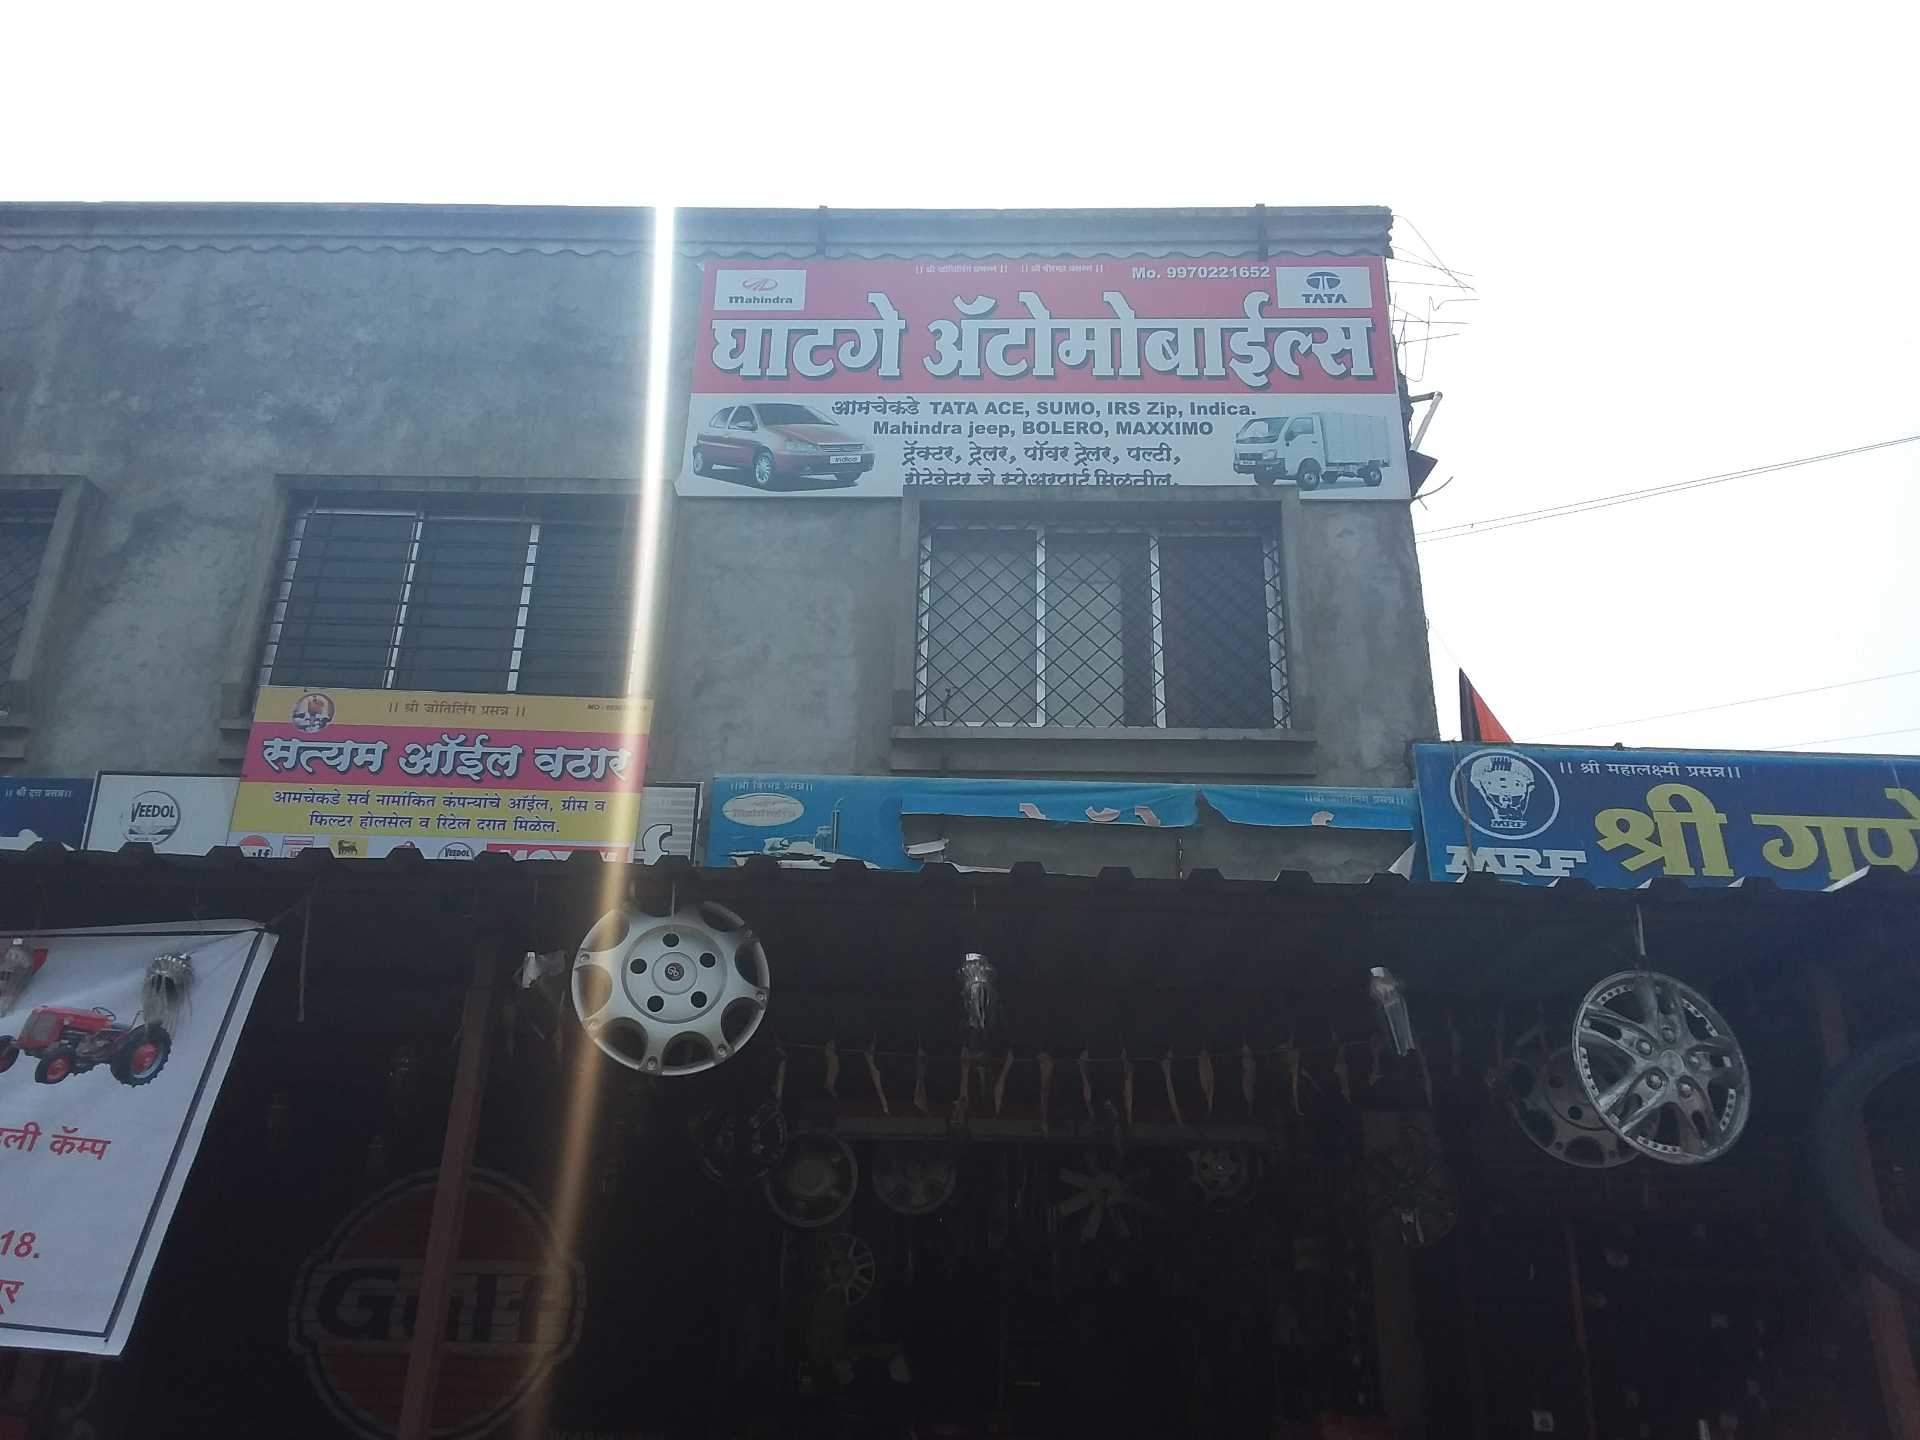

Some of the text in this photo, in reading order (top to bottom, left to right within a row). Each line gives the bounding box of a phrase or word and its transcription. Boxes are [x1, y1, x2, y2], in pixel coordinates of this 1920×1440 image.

[1132, 266, 1271, 279] Mo. 9970221652
[1301, 293, 1348, 304] TATA
[711, 291, 907, 378] घाटगे
[930, 402, 978, 415] TATA
[985, 402, 1030, 417] ACE,
[1036, 402, 1101, 417] SUMO,
[1107, 402, 1141, 416] IRS
[1147, 402, 1183, 418] Zip,
[873, 421, 1213, 438] Mahindra jeep, BOLERO, MAXXIMO
[1024, 440, 1069, 462] पॉवर
[263, 738, 388, 774] सत्यम
[399, 734, 523, 781] ऑईल
[1580, 760, 1601, 775] श्री
[1606, 761, 1681, 778] महालक्ष्मी
[347, 790, 370, 806] सर्व
[376, 790, 437, 808] नामांकित
[560, 796, 588, 812] ग्रीस
[594, 799, 607, 812] व
[131, 802, 176, 823] VEEDOL
[309, 810, 354, 827] फिल्टर
[360, 811, 414, 830] होलसेल
[419, 817, 431, 829] व
[436, 813, 471, 831] रिटेल
[476, 818, 507, 832] दरात
[1595, 783, 1736, 878] श्री
[1445, 845, 1588, 878] MRF
[0, 1121, 112, 1161] ली कॅम्प
